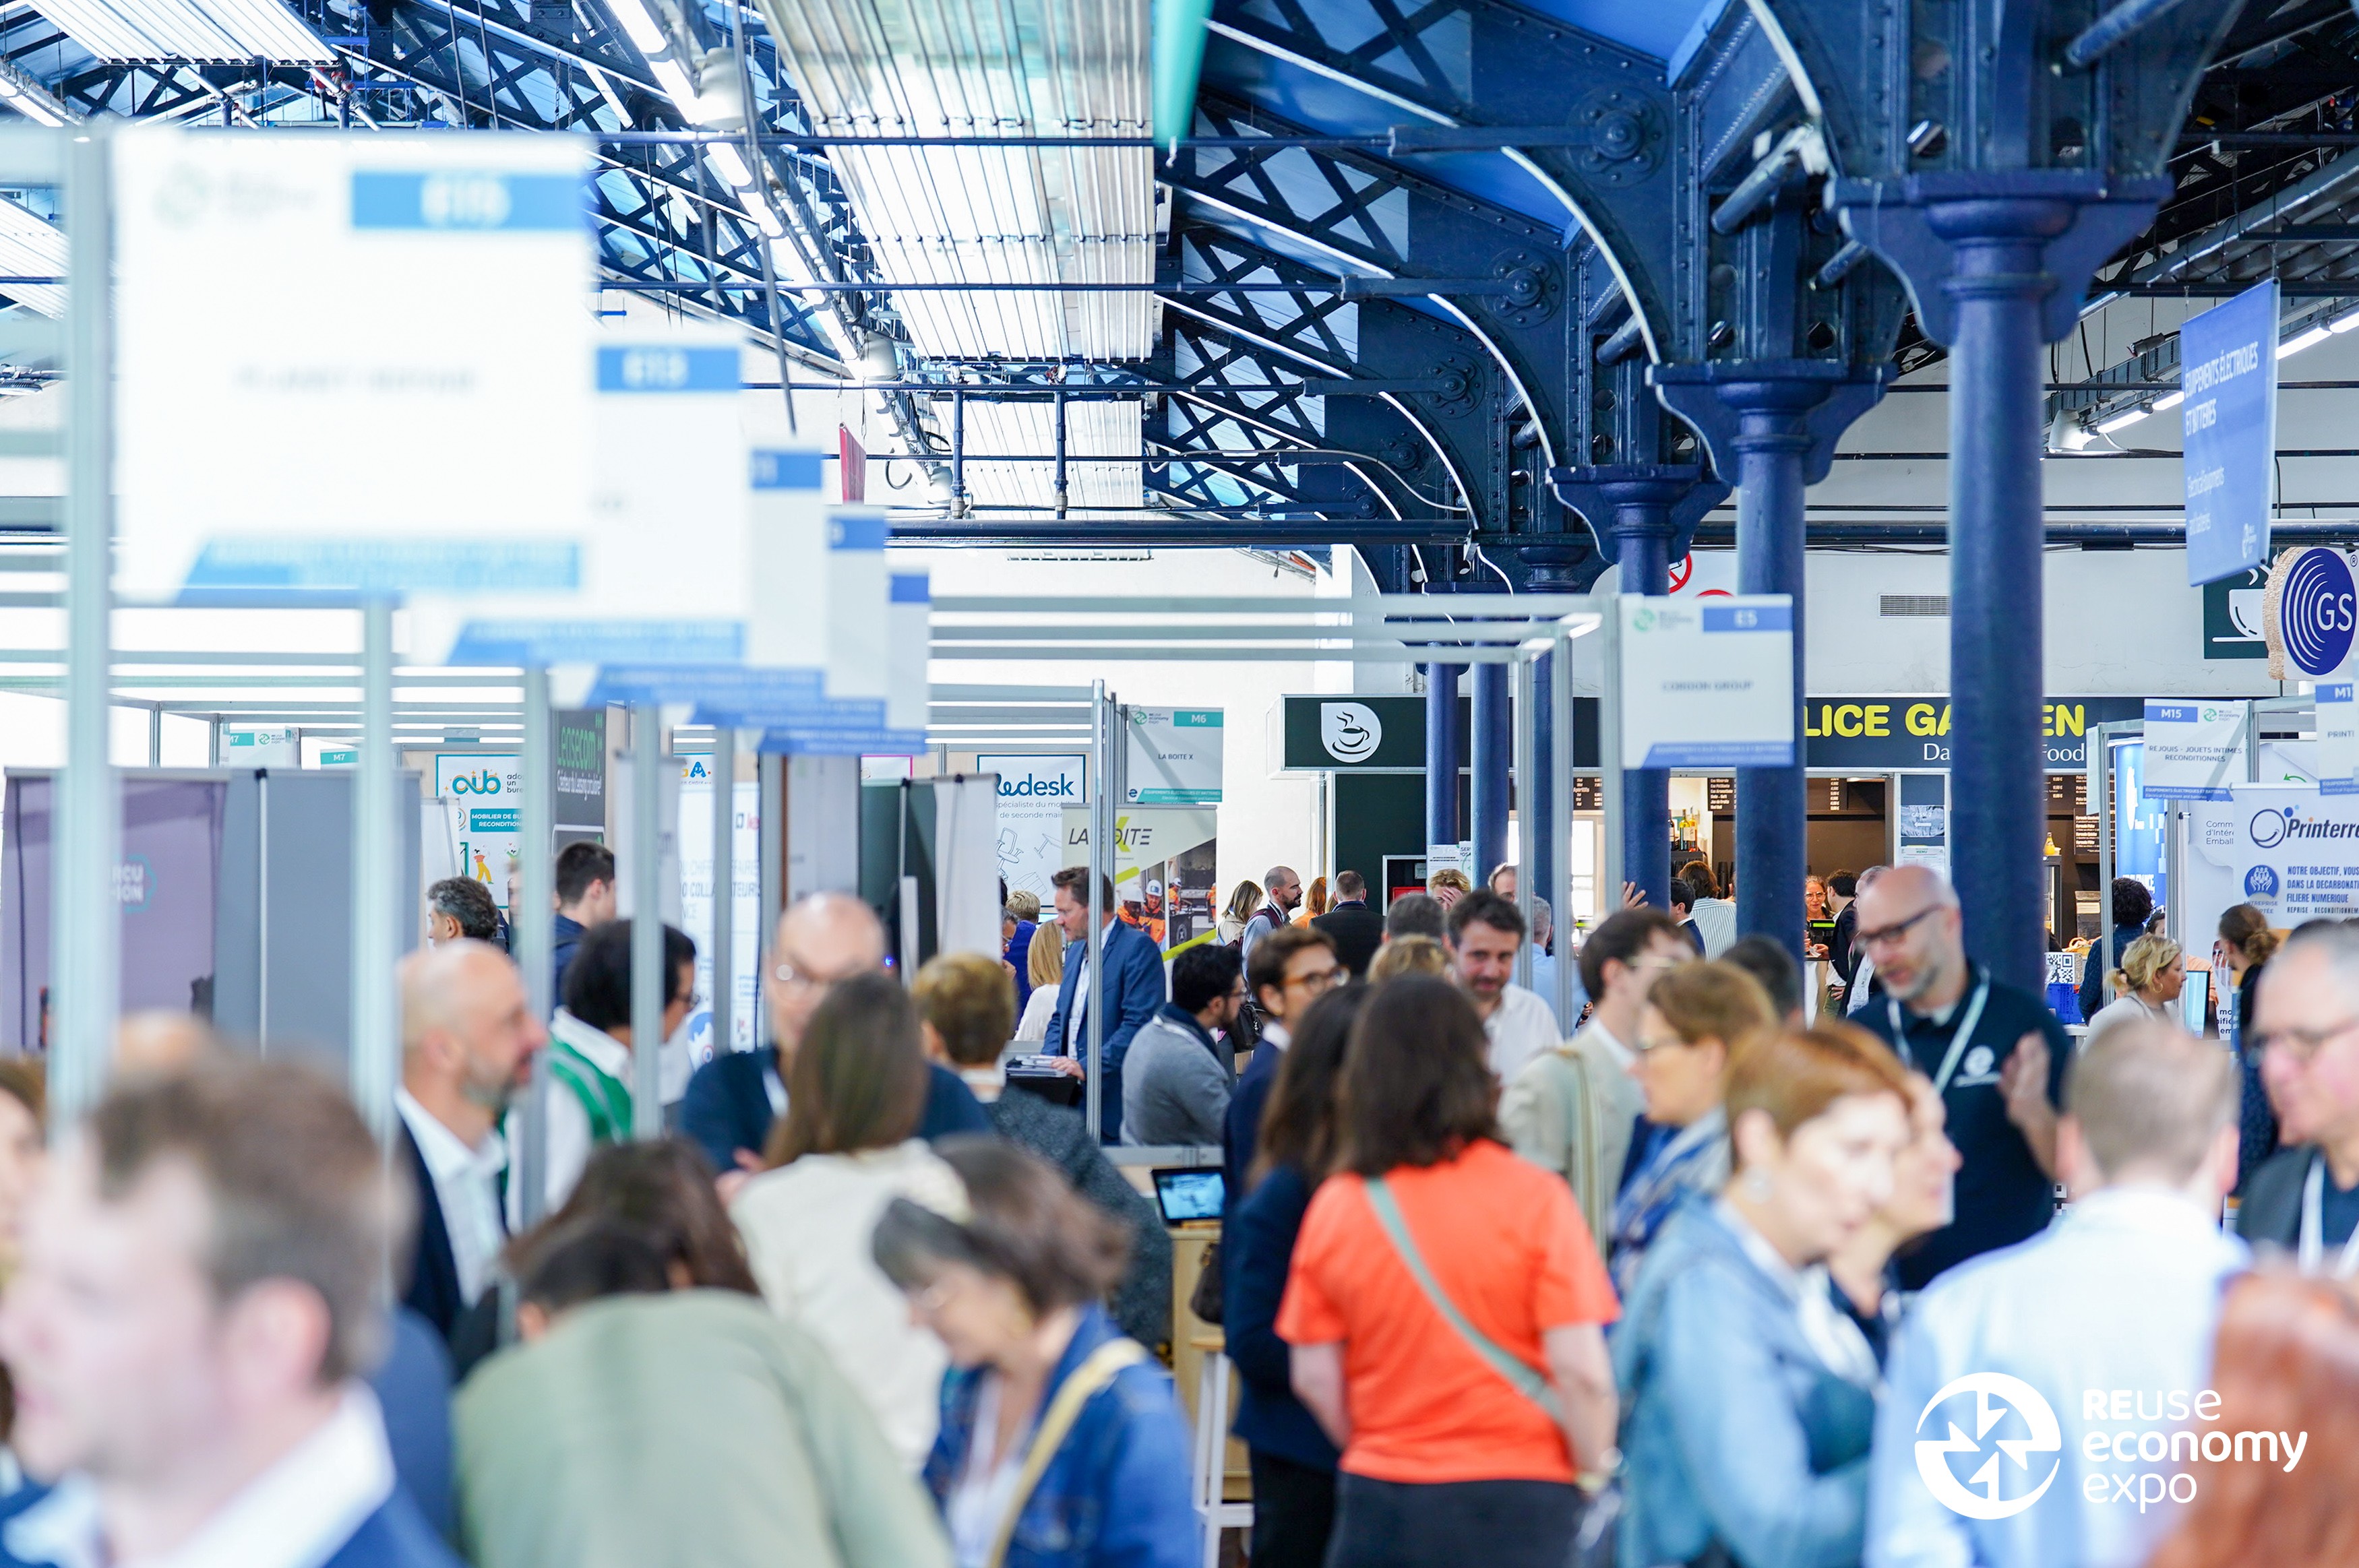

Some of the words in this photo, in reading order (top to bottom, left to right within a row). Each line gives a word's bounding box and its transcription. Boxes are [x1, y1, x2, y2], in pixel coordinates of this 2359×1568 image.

[1662, 680, 1711, 692] CORDON
[1715, 680, 1754, 692] GROUP
[2334, 687, 2352, 699] M1
[2161, 709, 2182, 718] M15
[1191, 715, 1206, 723] M6
[1804, 704, 1890, 737] LICE
[995, 801, 1034, 810] spécialiste
[1068, 828, 1089, 845] LA
[1114, 828, 1153, 845] OITE
[2288, 866, 2308, 875] NOTRE
[2310, 866, 2342, 877] OBJECTIF,
[2343, 867, 2359, 876] VOUS
[2287, 879, 2304, 889] DANS
[2306, 880, 2315, 889] LA
[2287, 893, 2309, 902] FILIERE
[2311, 893, 2349, 903] NUMERIQUE
